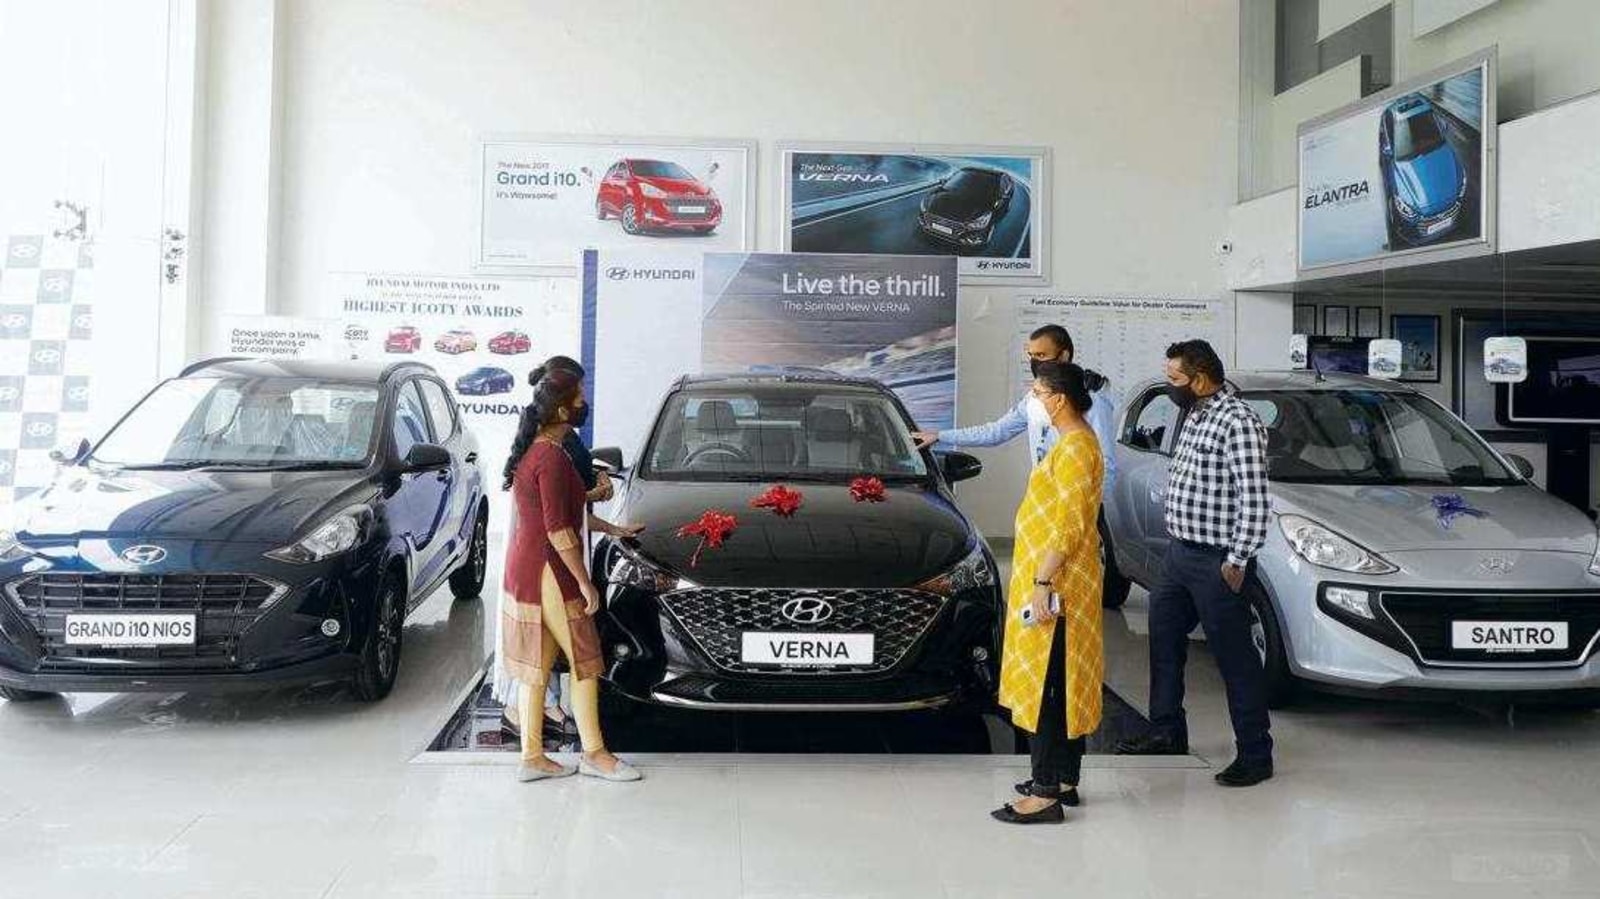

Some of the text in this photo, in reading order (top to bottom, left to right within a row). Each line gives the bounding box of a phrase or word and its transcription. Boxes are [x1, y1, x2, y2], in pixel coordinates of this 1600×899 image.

[497, 171, 581, 187] Grand i10.
[800, 173, 889, 182] VERNA
[1304, 180, 1369, 209] ELANTRA
[633, 269, 695, 280] HYUNDAI
[782, 273, 946, 298] Live the thrill.
[344, 300, 523, 318] HIGHEST ICOTY AWARDS
[783, 301, 911, 313] The Spirited New VERNA
[1048, 300, 1078, 308] Economy
[232, 329, 259, 337] Once
[260, 330, 286, 339] upon
[456, 403, 526, 415] YUNDA
[68, 621, 192, 637] GRAND i10 NIOS
[1471, 627, 1555, 645] SANTRO
[769, 641, 850, 658] VERNA
